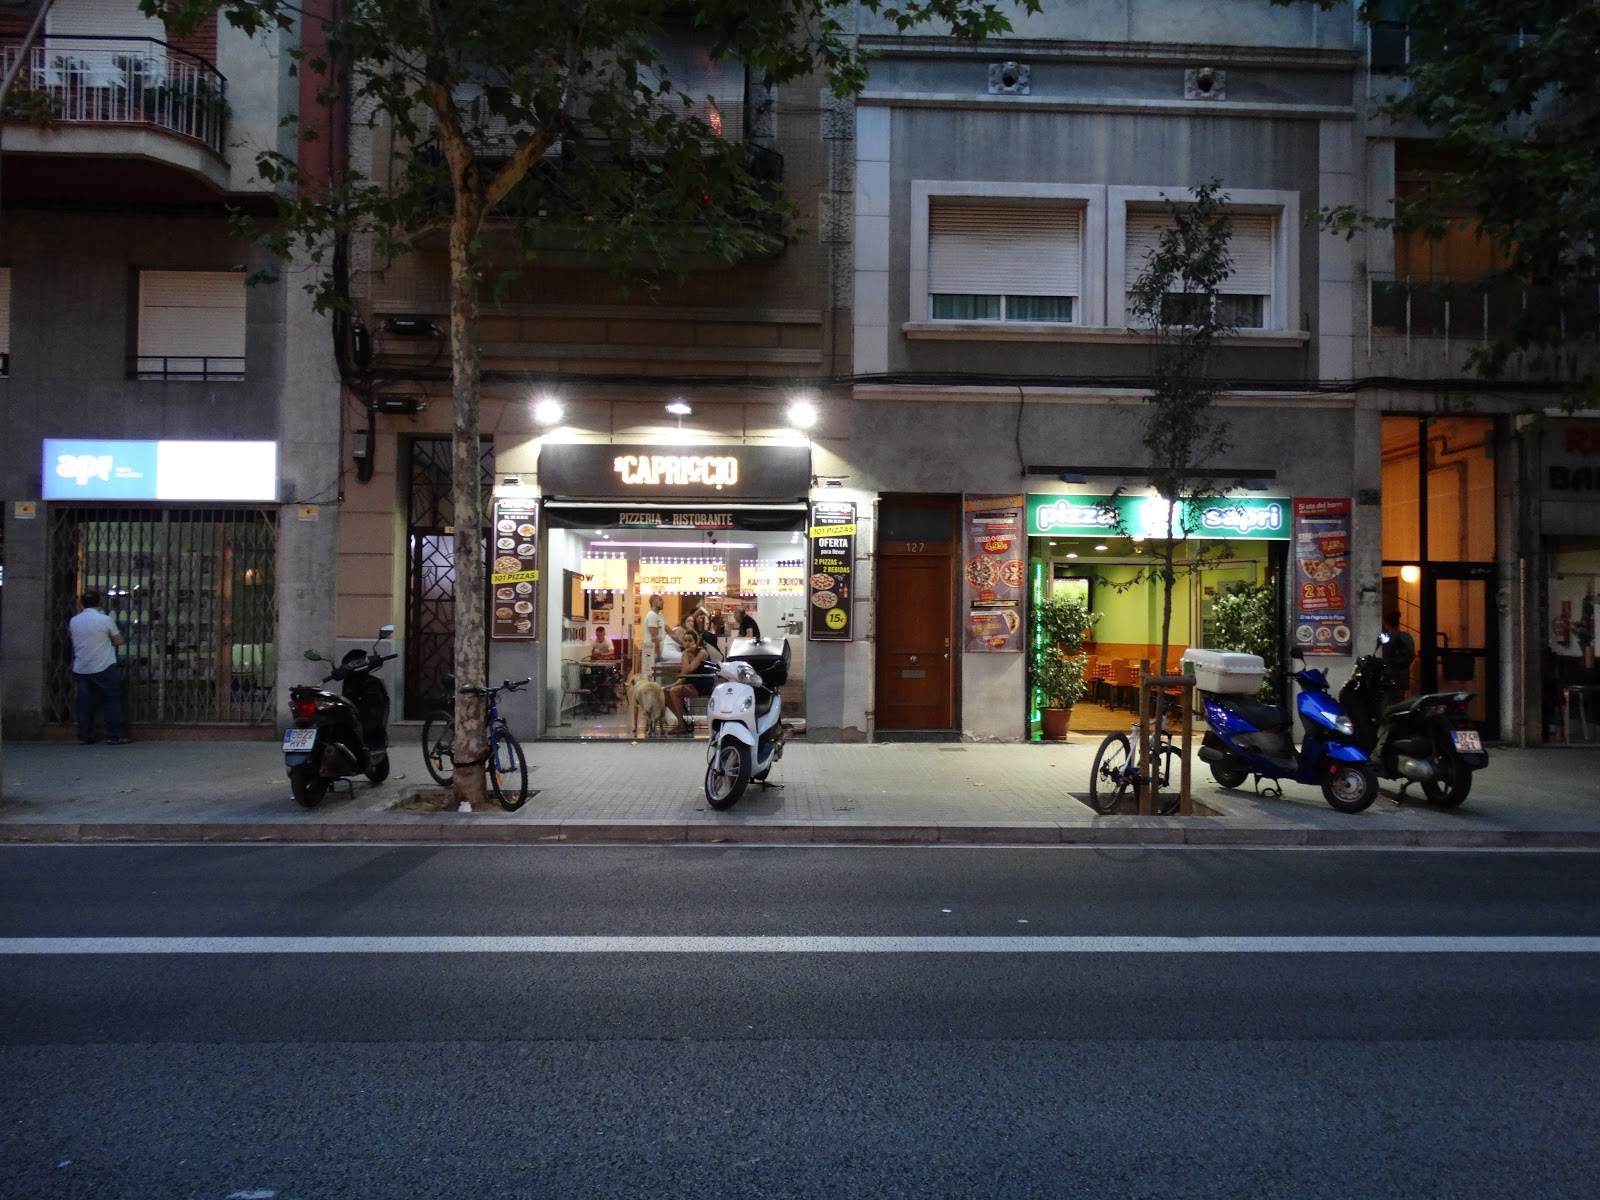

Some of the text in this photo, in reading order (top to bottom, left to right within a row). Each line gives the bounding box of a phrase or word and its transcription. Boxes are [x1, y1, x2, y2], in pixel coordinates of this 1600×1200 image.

[1549, 466, 1600, 491] BA
[619, 513, 733, 526] PIZZERIA RISTORANTE
[1036, 500, 1118, 531] pizza
[1202, 503, 1282, 534] sapri
[826, 526, 854, 534] PIZZAS
[818, 538, 848, 548] OFERTA
[905, 542, 925, 553] 127
[819, 558, 838, 566] PIZZAS
[507, 572, 535, 581] PIZZAS
[1304, 584, 1315, 598] 2
[1327, 583, 1336, 596] 1
